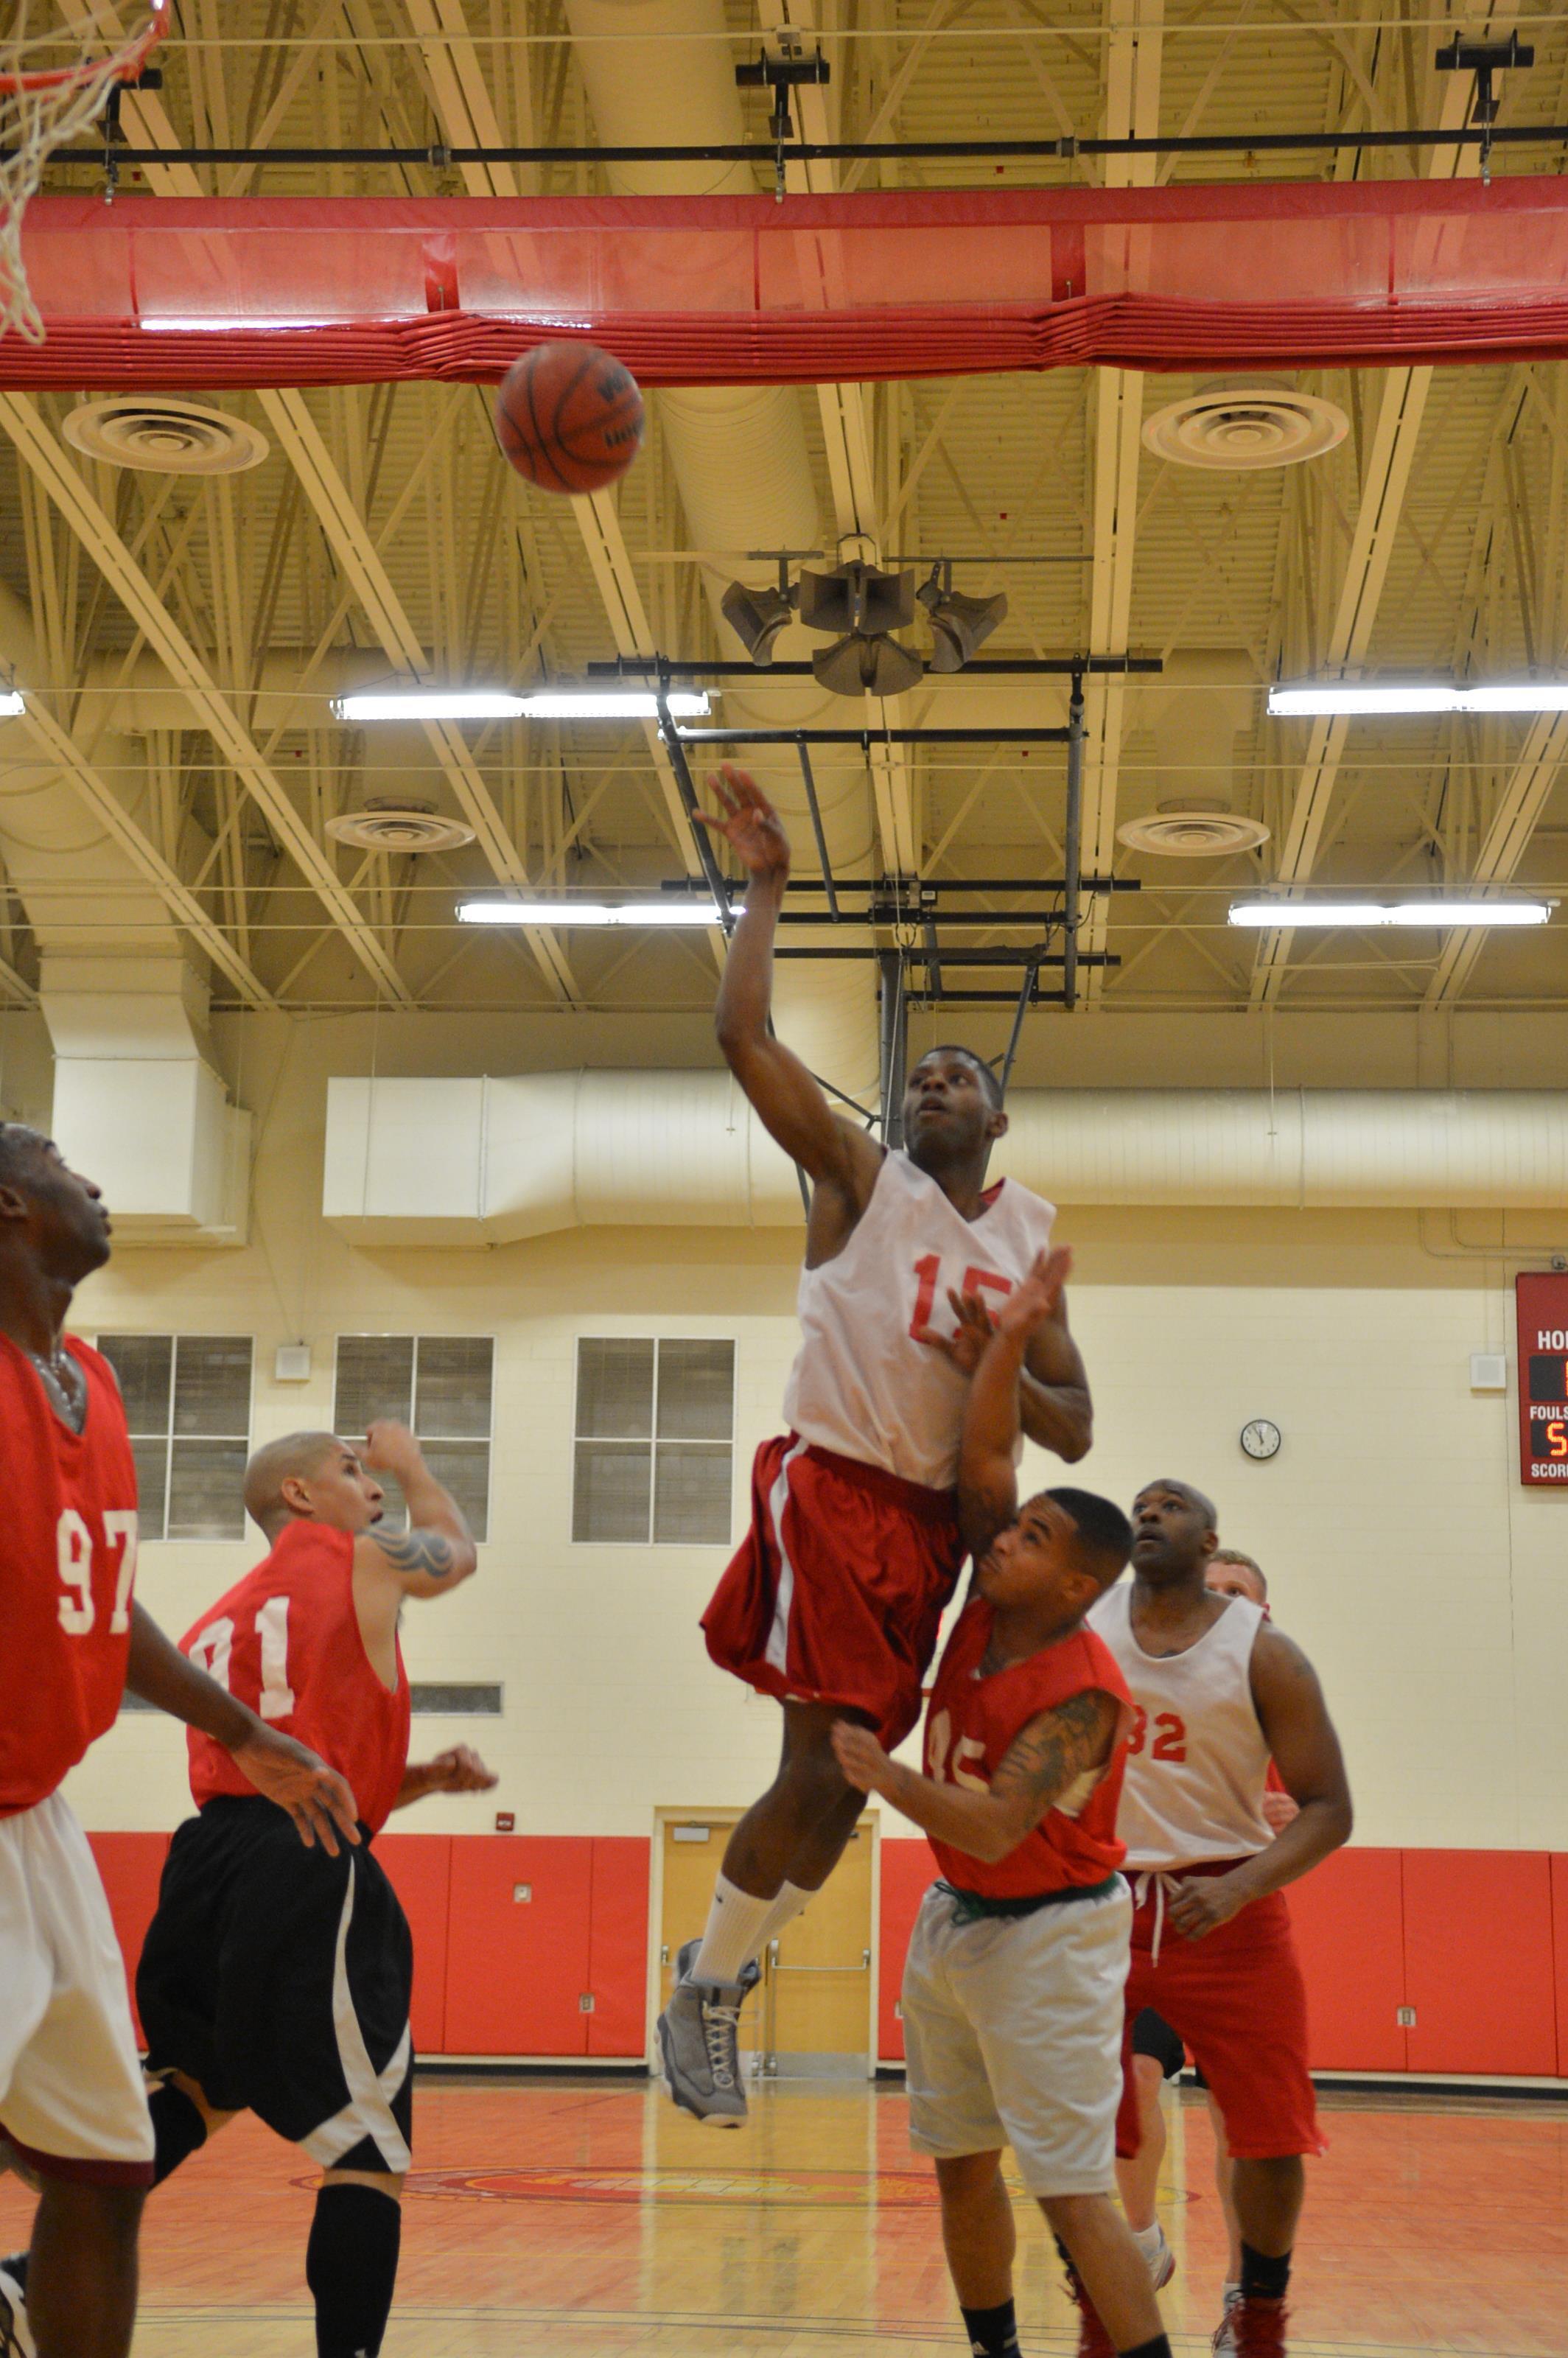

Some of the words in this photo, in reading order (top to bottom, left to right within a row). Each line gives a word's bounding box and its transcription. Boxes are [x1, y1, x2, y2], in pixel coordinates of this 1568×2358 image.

[1538, 1329, 1568, 1350] HO
[1547, 1421, 1567, 1456] 5
[1531, 1463, 1568, 1477] SCOR
[57, 1508, 138, 1634] 97
